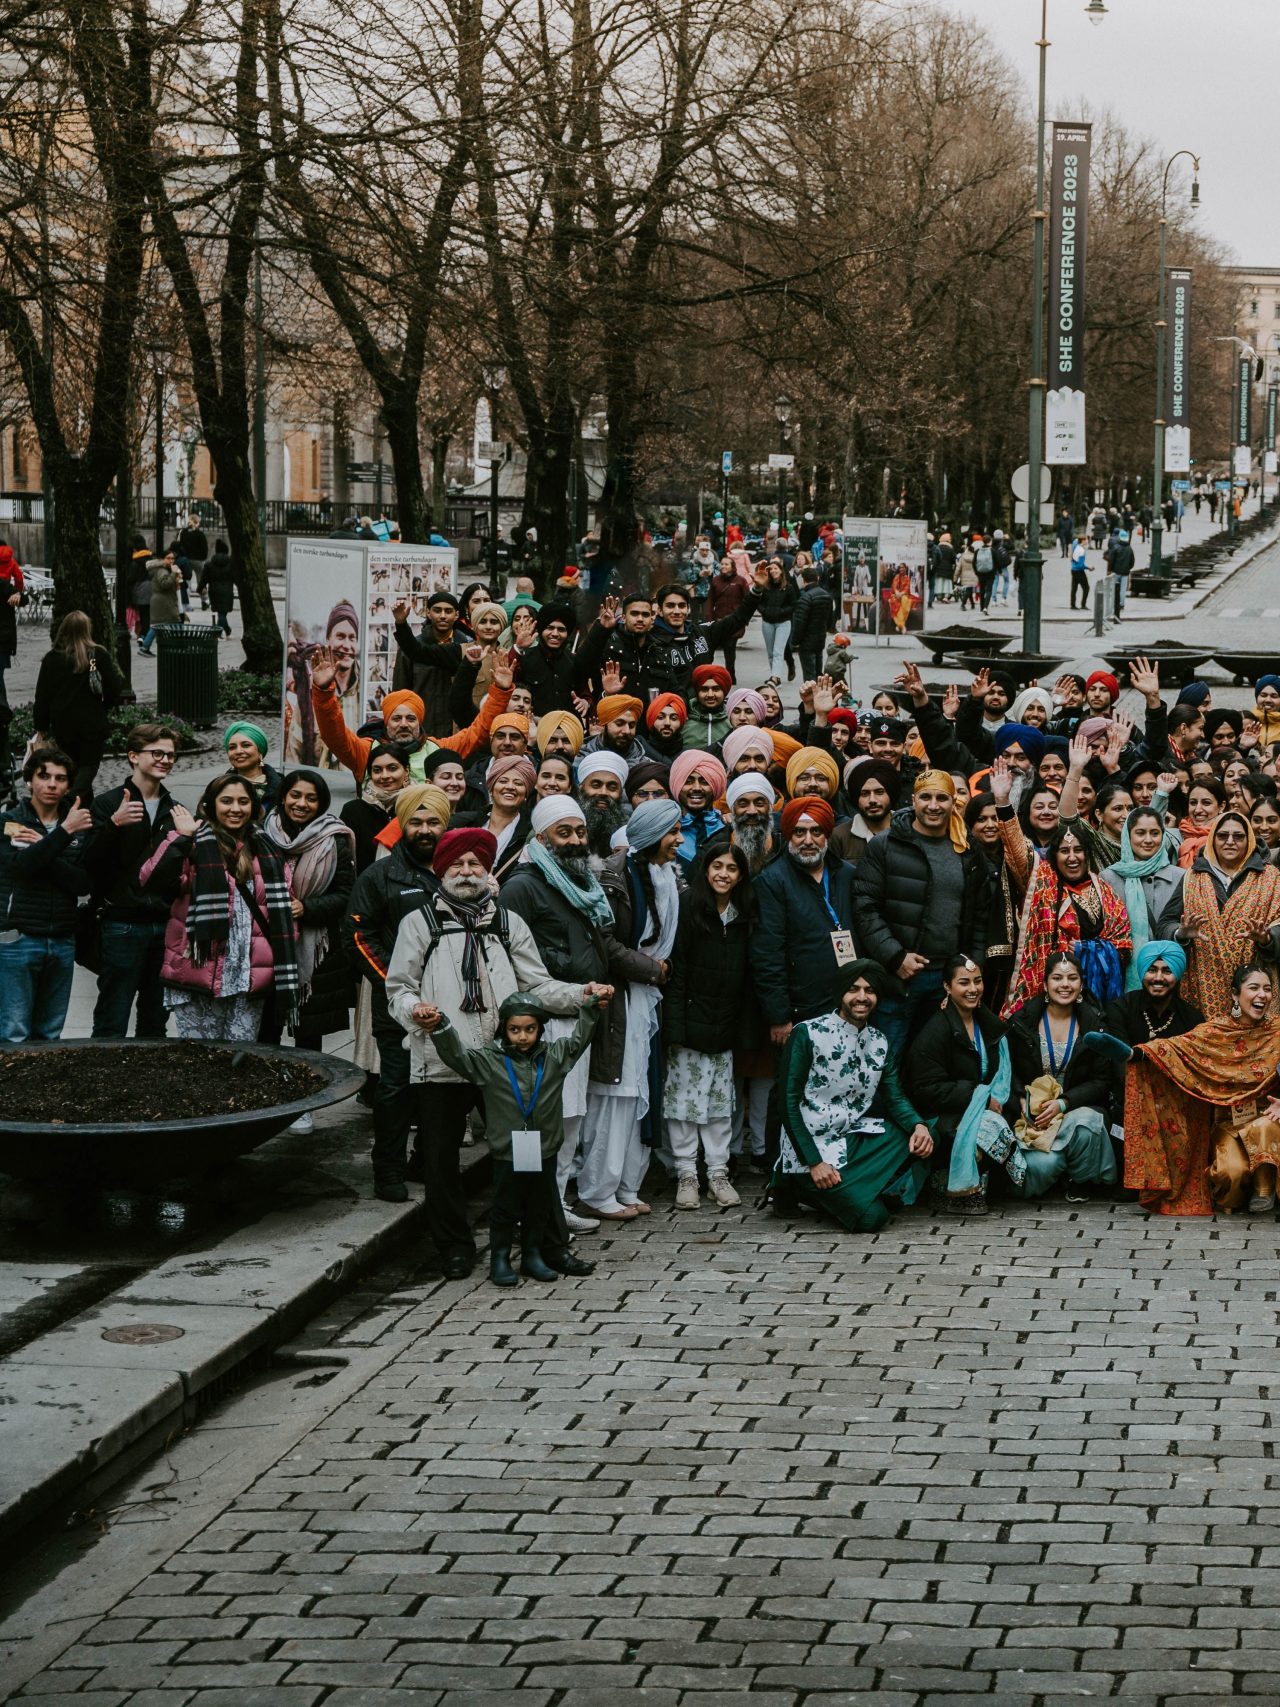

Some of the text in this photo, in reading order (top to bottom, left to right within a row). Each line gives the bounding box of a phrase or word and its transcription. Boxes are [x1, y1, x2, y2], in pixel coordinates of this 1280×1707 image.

[1059, 154, 1078, 373] SHE CONFERENCE 2023
[1173, 286, 1185, 417] SHE CONFERENCE 2023
